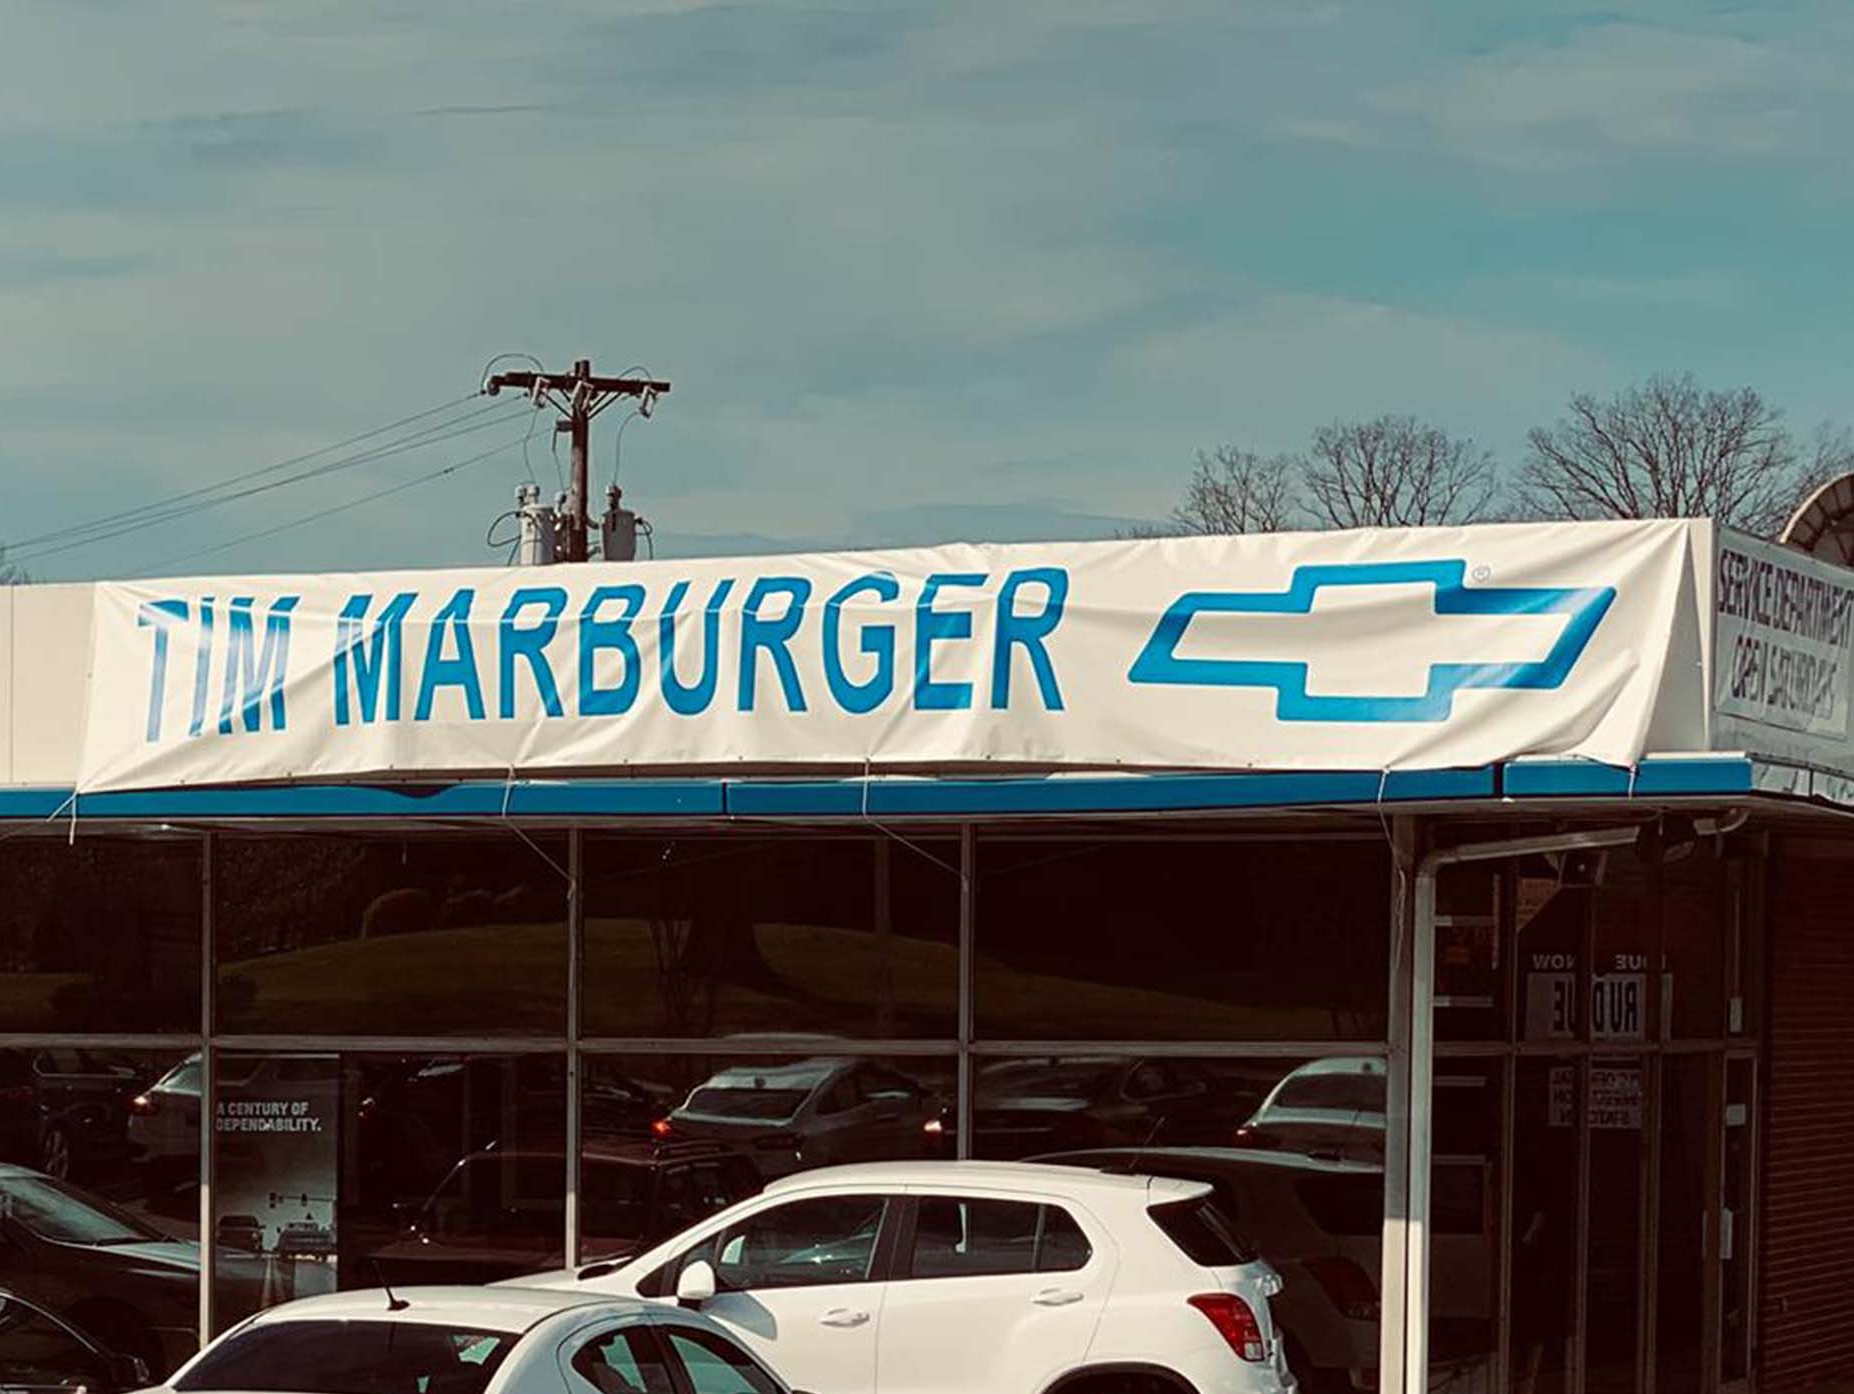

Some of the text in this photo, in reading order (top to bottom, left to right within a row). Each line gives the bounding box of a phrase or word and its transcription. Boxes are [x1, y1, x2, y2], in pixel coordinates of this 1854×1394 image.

[1719, 548, 1773, 627] SERVICE
[138, 566, 1070, 743] TIM MARBURGER
[216, 1101, 309, 1116] A CENTURY OF
